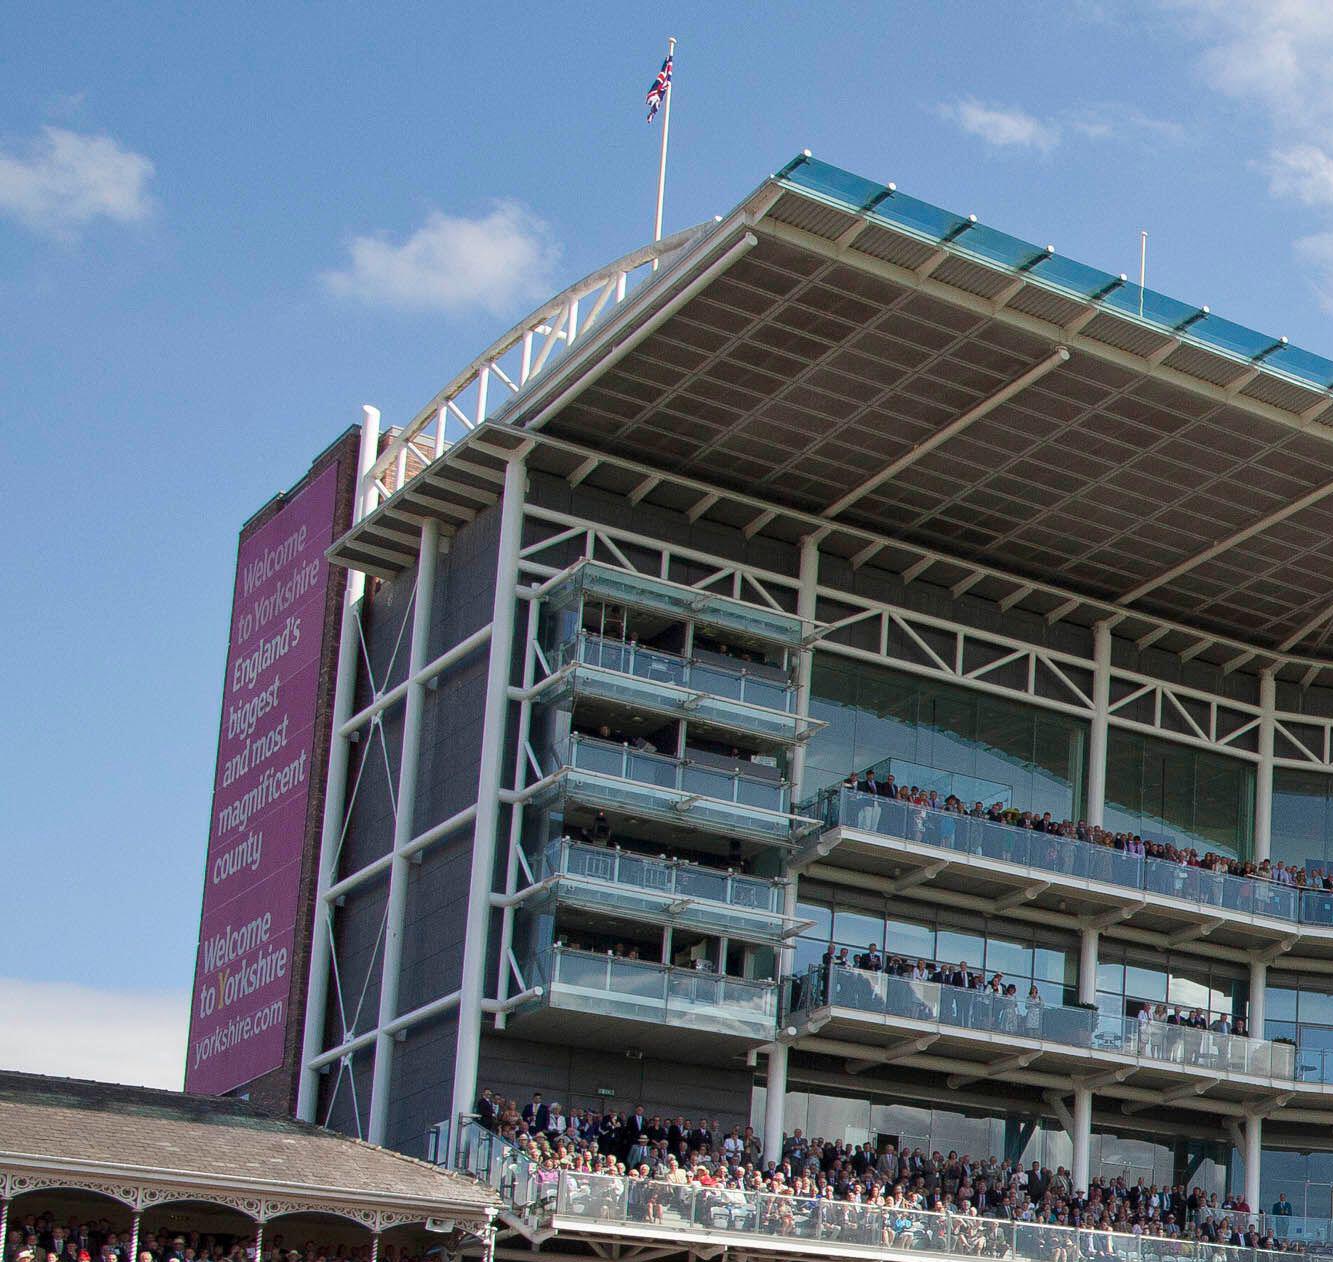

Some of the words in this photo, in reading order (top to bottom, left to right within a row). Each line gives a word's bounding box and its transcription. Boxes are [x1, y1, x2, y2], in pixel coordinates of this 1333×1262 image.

[243, 525, 307, 598] Welcome
[237, 611, 251, 645] to
[254, 558, 320, 633] Yorkshire
[232, 616, 301, 694] England's
[227, 675, 281, 742] biggest
[222, 738, 251, 789] and
[252, 713, 289, 767] most
[217, 750, 306, 836] magnificent
[213, 831, 263, 885] county
[204, 912, 272, 975] Welcome
[199, 980, 216, 1020] to
[217, 946, 287, 1010] Yorkshire
[194, 999, 283, 1070] yorkshire.com
